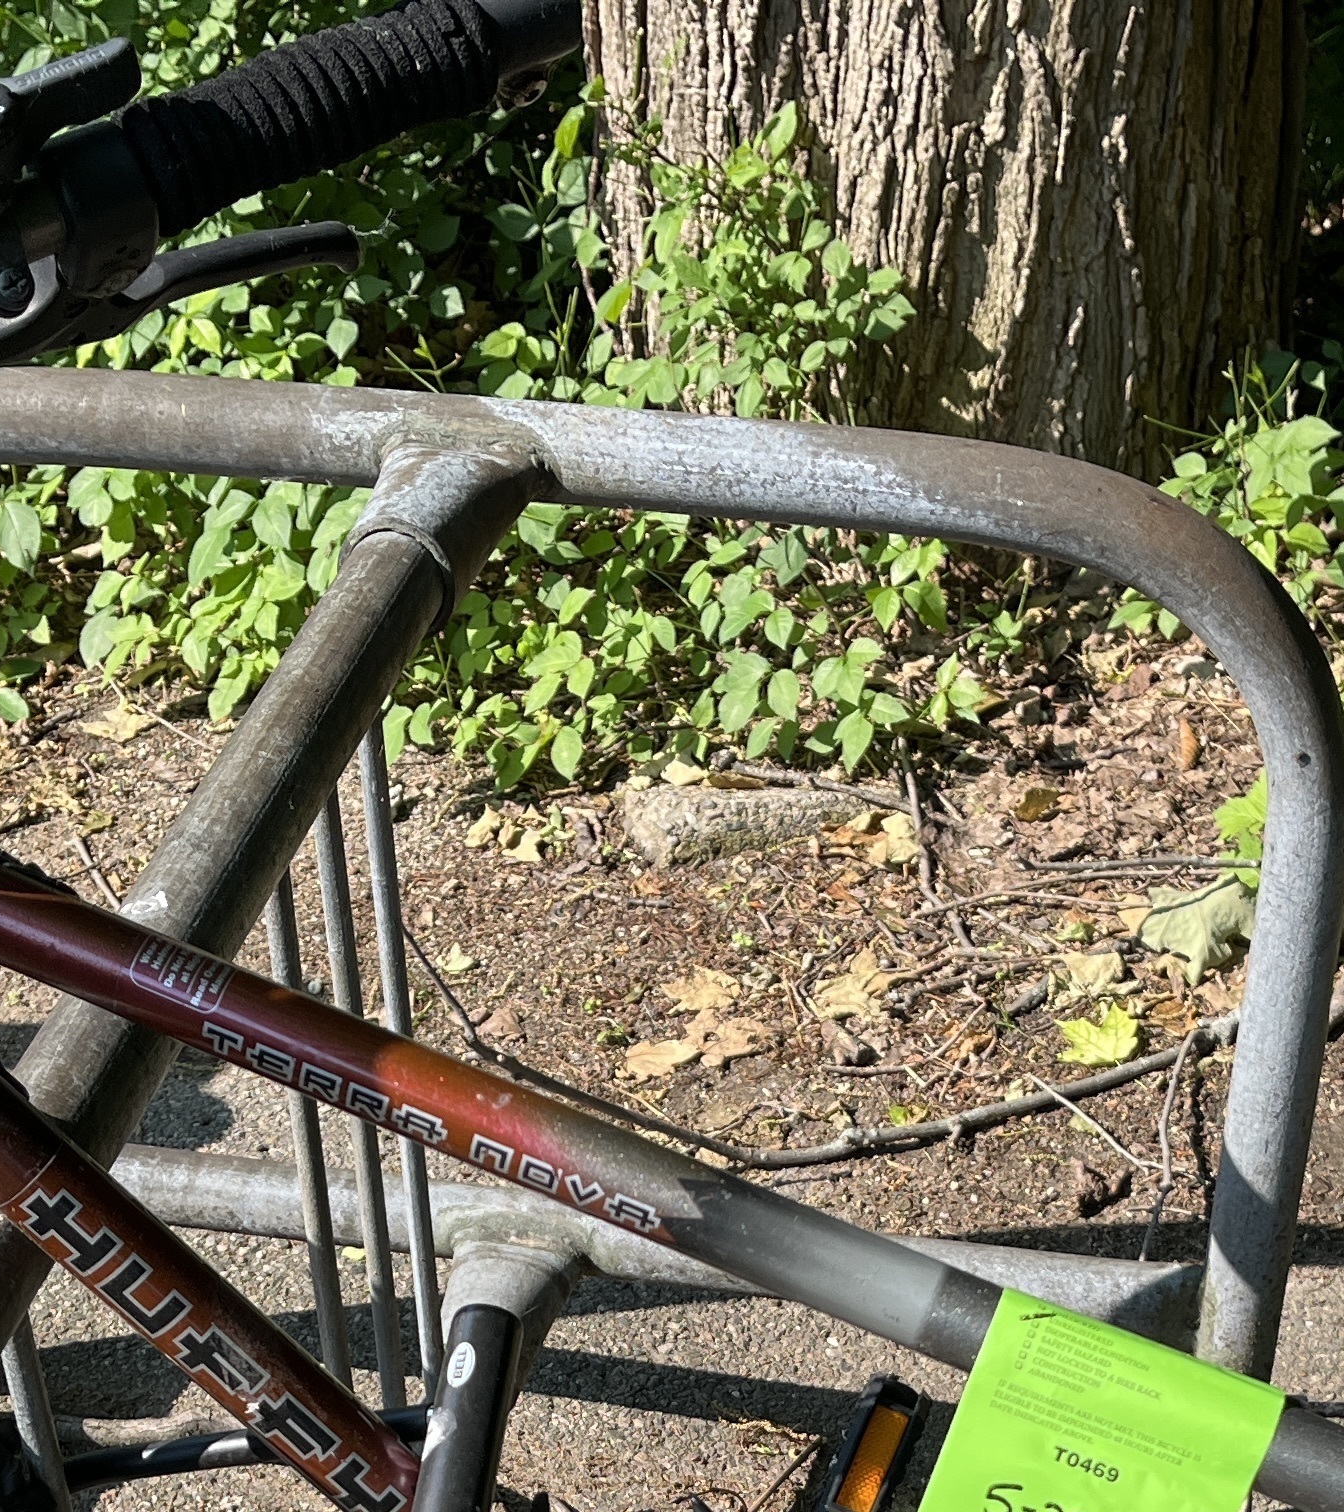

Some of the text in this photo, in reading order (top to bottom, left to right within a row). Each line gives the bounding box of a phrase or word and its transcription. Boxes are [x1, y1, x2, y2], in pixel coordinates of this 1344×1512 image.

[202, 1021, 661, 1234] TERRA NOVA
[453, 1349, 467, 1378] BELL
[1041, 1335, 1111, 1368] SAFETY HAZARD
[1099, 1346, 1149, 1372] CONDITION
[1028, 1366, 1084, 1394] ABANDONED
[1037, 1346, 1057, 1359] NOT
[1057, 1354, 1092, 1373] LOCKED
[1093, 1368, 1108, 1378] TO
[1136, 1384, 1161, 1399] RACK
[989, 1400, 1013, 1414] DATE
[1014, 1408, 1061, 1433] INDICATED
[1008, 1381, 1074, 1414] REQUIREMENTS
[1075, 1408, 1094, 1420] ARE
[1094, 1415, 1113, 1427] NOT
[1134, 1430, 1155, 1444] THIS
[1156, 1439, 1191, 1458] BICYCLE
[1033, 1405, 1046, 1414] TO
[1058, 1413, 1111, 1440] IMPOUNDED
[1124, 1438, 1153, 1455] HOURS
[1154, 1450, 1182, 1466] AFTER
[1054, 1445, 1120, 1482] T0469
